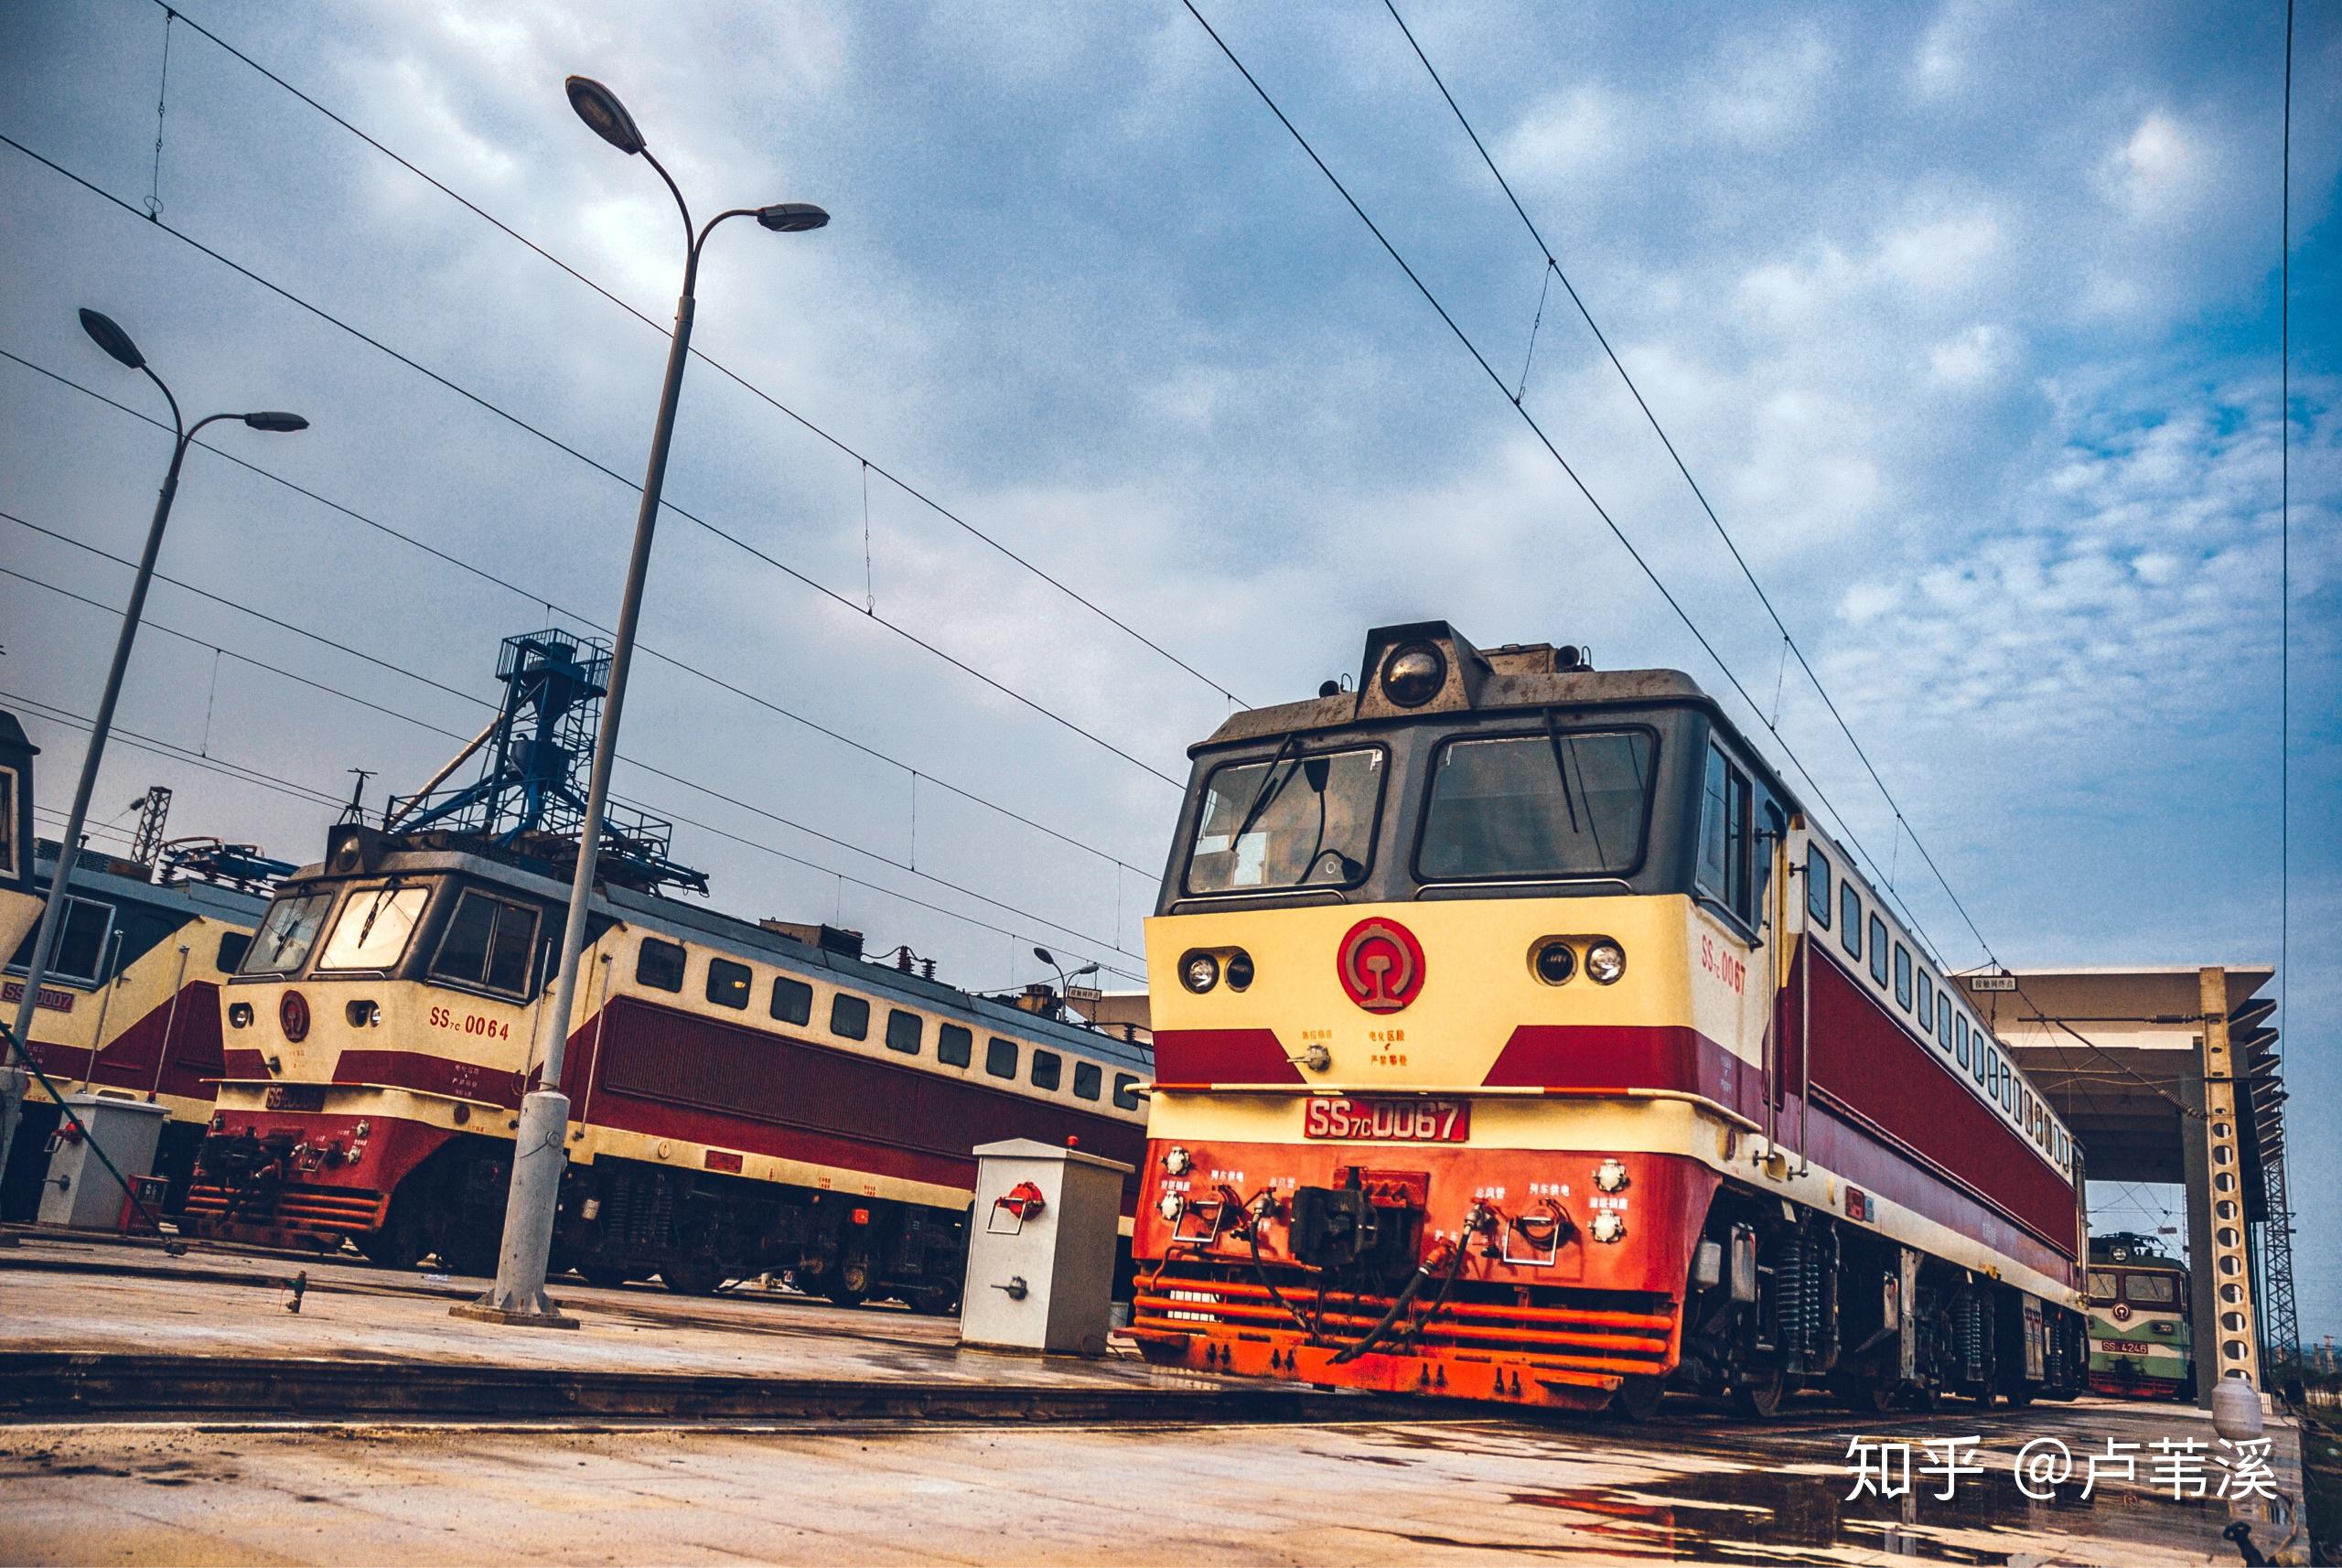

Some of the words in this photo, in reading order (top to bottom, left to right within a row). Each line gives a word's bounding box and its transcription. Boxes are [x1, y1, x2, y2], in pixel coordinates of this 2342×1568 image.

[1722, 950, 1746, 996] 0067
[465, 1015, 509, 1041] 0064
[1369, 1029, 1405, 1042] 电化区段
[1308, 1099, 1459, 1140] SS7C0067
[1529, 1182, 1571, 1197] 列车供电
